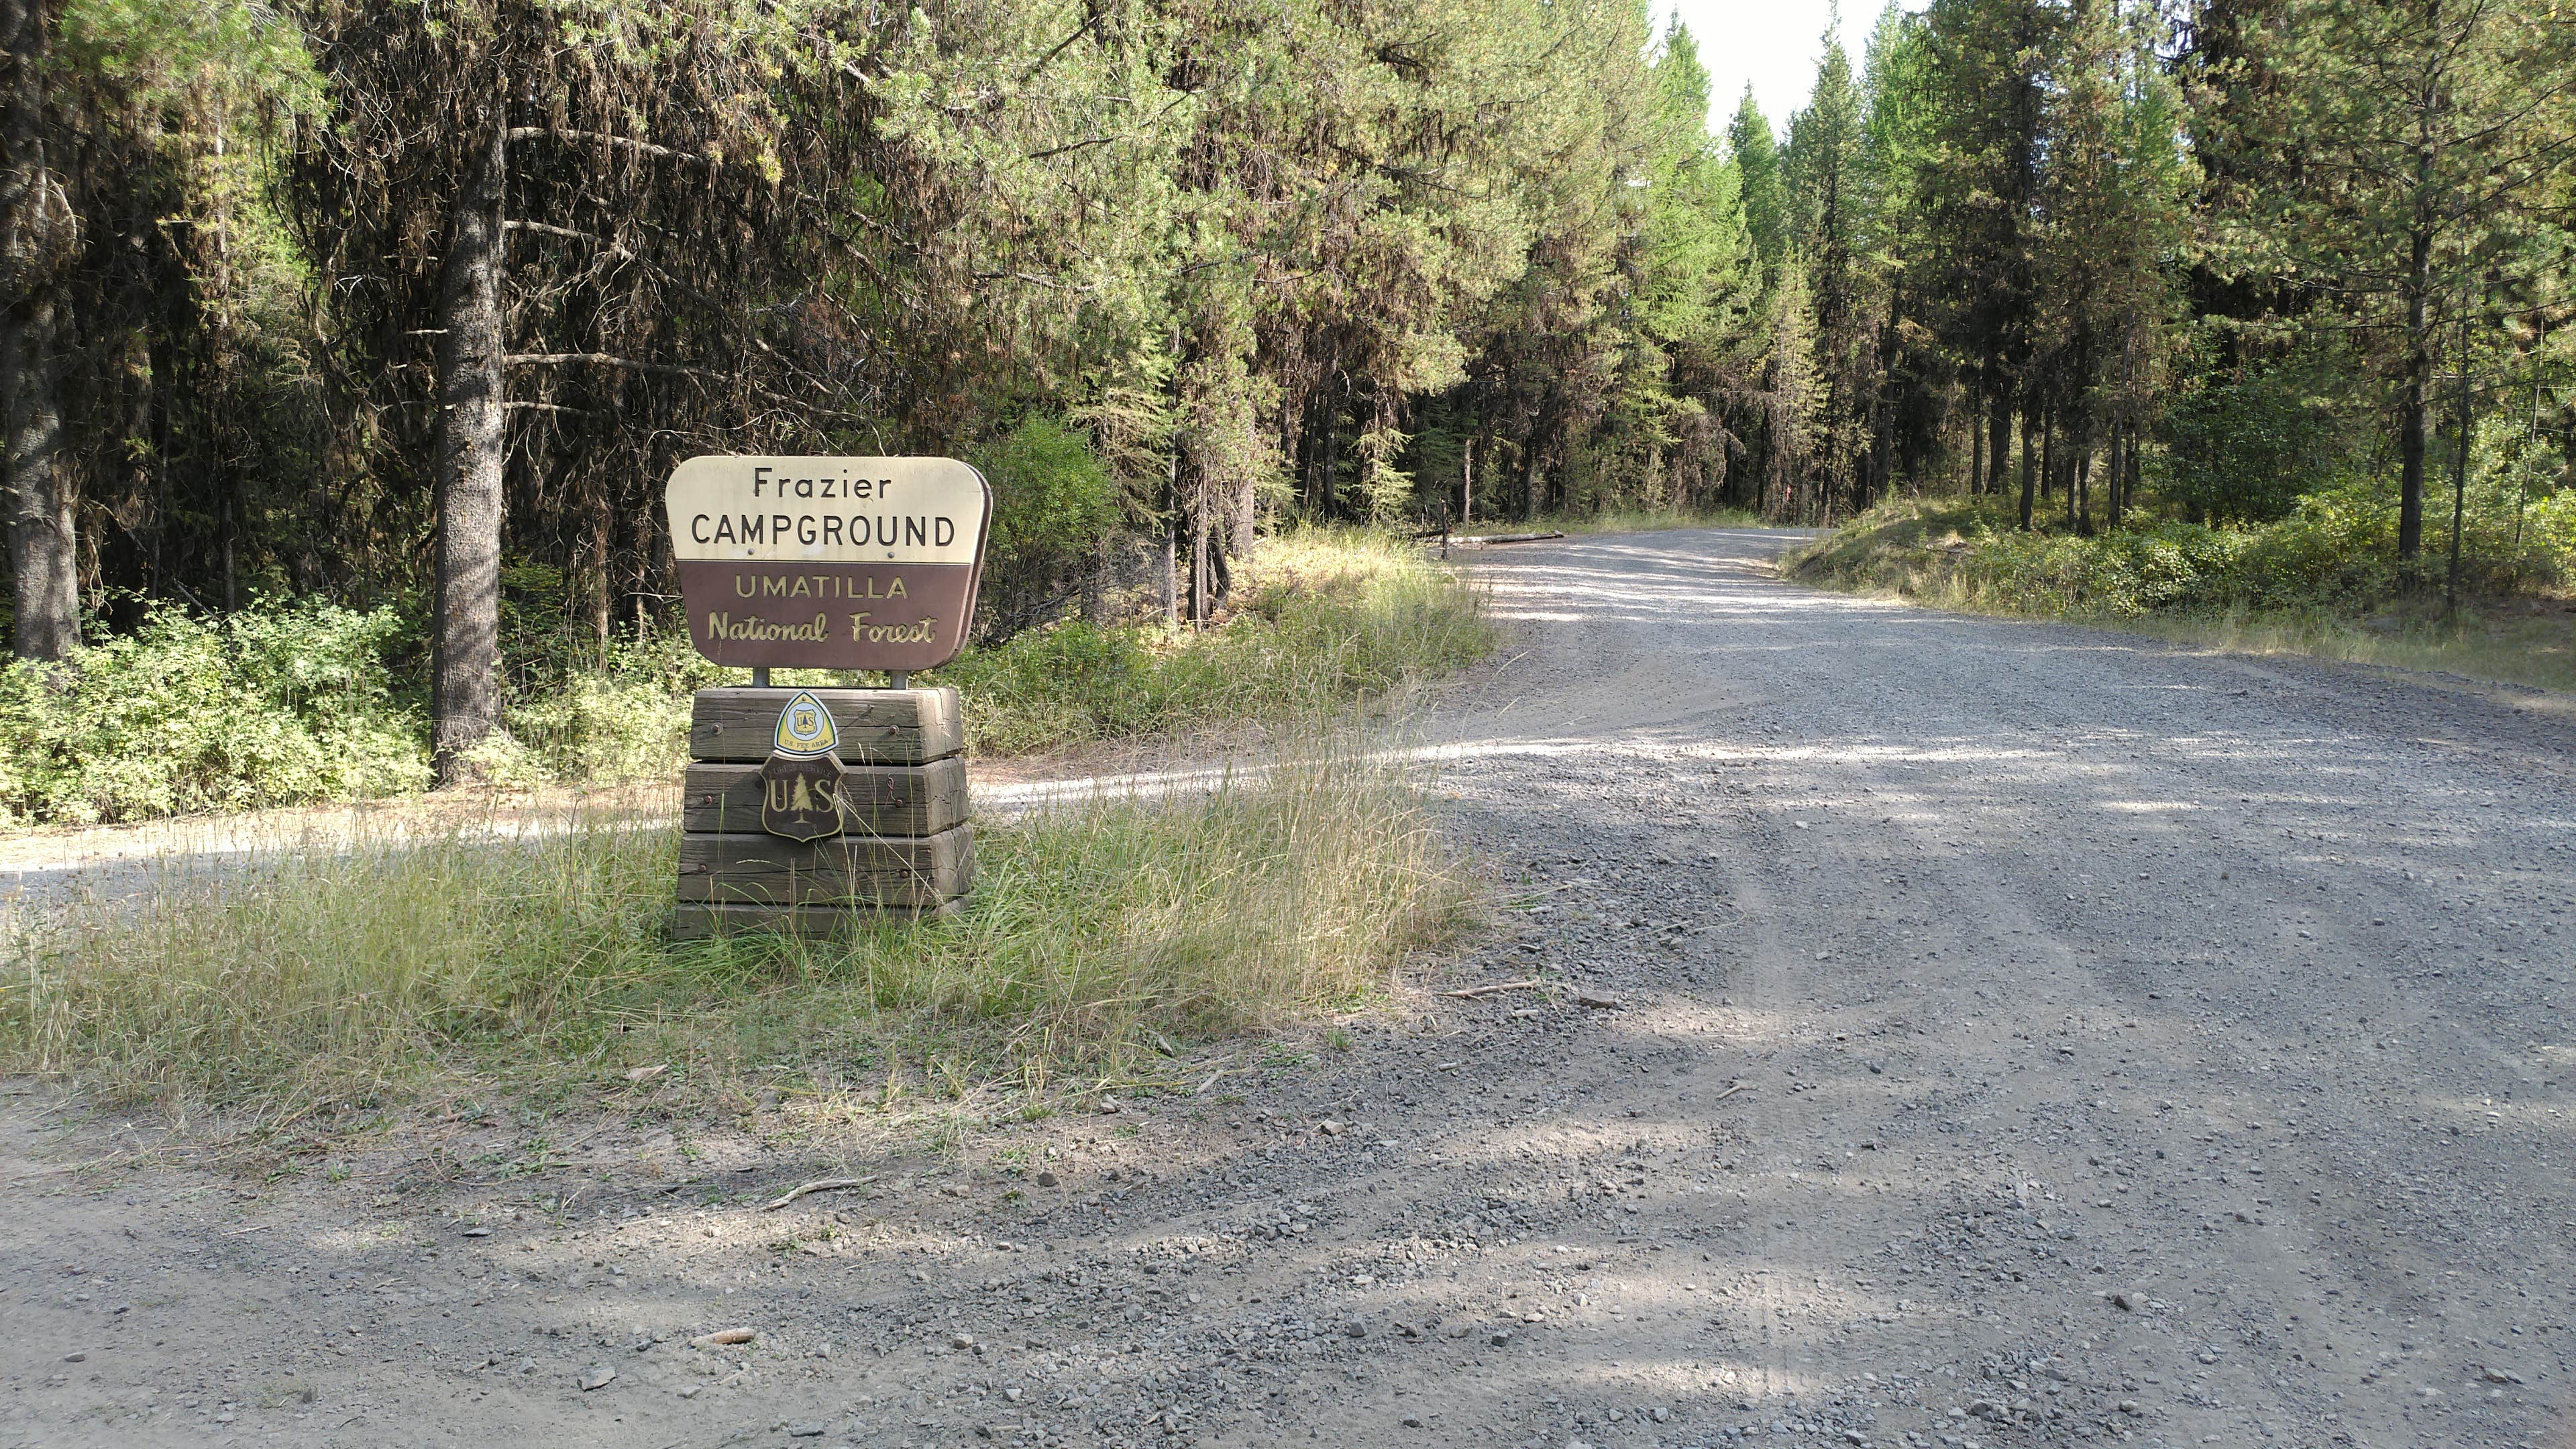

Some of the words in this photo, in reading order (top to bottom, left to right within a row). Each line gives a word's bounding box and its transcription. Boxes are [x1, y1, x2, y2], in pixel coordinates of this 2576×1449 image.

[753, 467, 892, 499] Frazier
[691, 514, 955, 547] CAMPGROUND
[735, 574, 909, 599] UMATILLA
[708, 611, 828, 643] National
[849, 611, 938, 644] Forest
[812, 739, 828, 748] AREA
